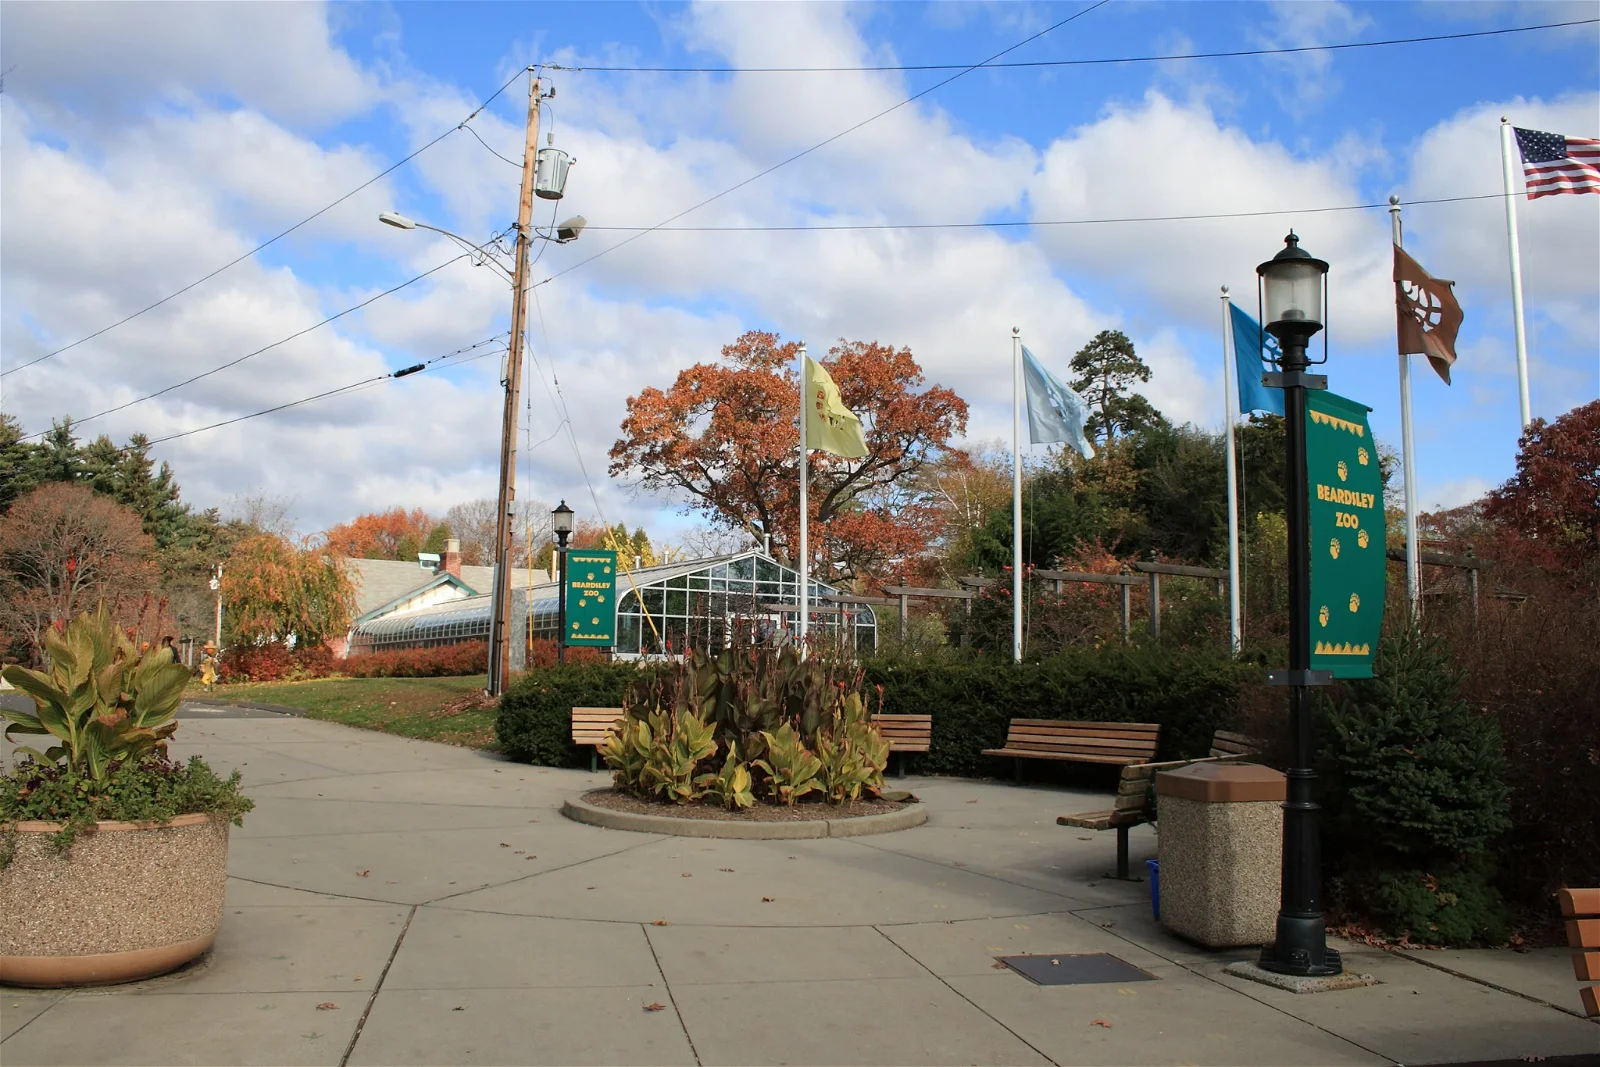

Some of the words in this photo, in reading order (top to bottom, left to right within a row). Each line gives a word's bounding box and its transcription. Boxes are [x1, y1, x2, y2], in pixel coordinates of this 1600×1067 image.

[1317, 484, 1375, 509] BEARDSLEY
[1335, 511, 1359, 530] ZOO
[571, 581, 611, 589] BEARDSLEY
